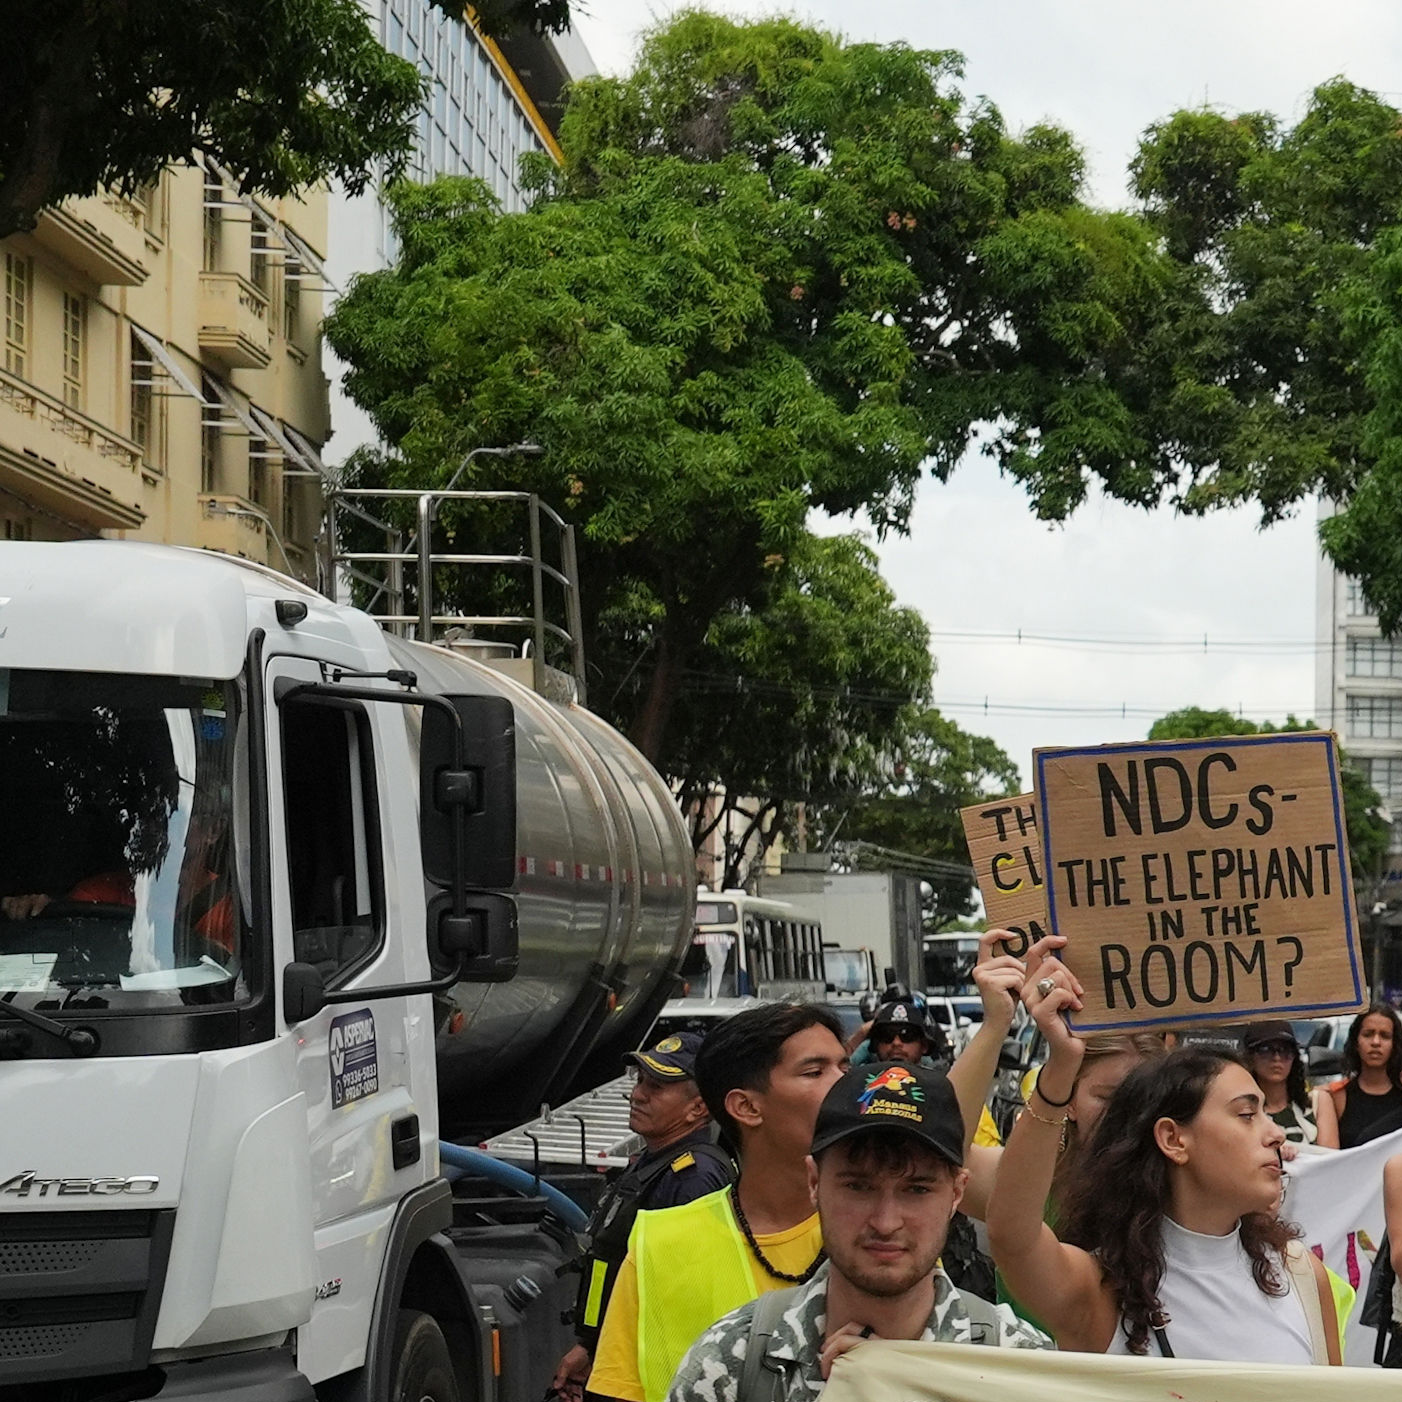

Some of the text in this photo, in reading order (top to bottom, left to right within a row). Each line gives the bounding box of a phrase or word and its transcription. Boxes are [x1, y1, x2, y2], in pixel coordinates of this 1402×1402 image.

[1057, 844, 1336, 907] THE ELEPHANT
[1147, 903, 1261, 941] IN THE
[1101, 936, 1305, 1009] ROOM?
[865, 1106, 922, 1123] Amazonas
